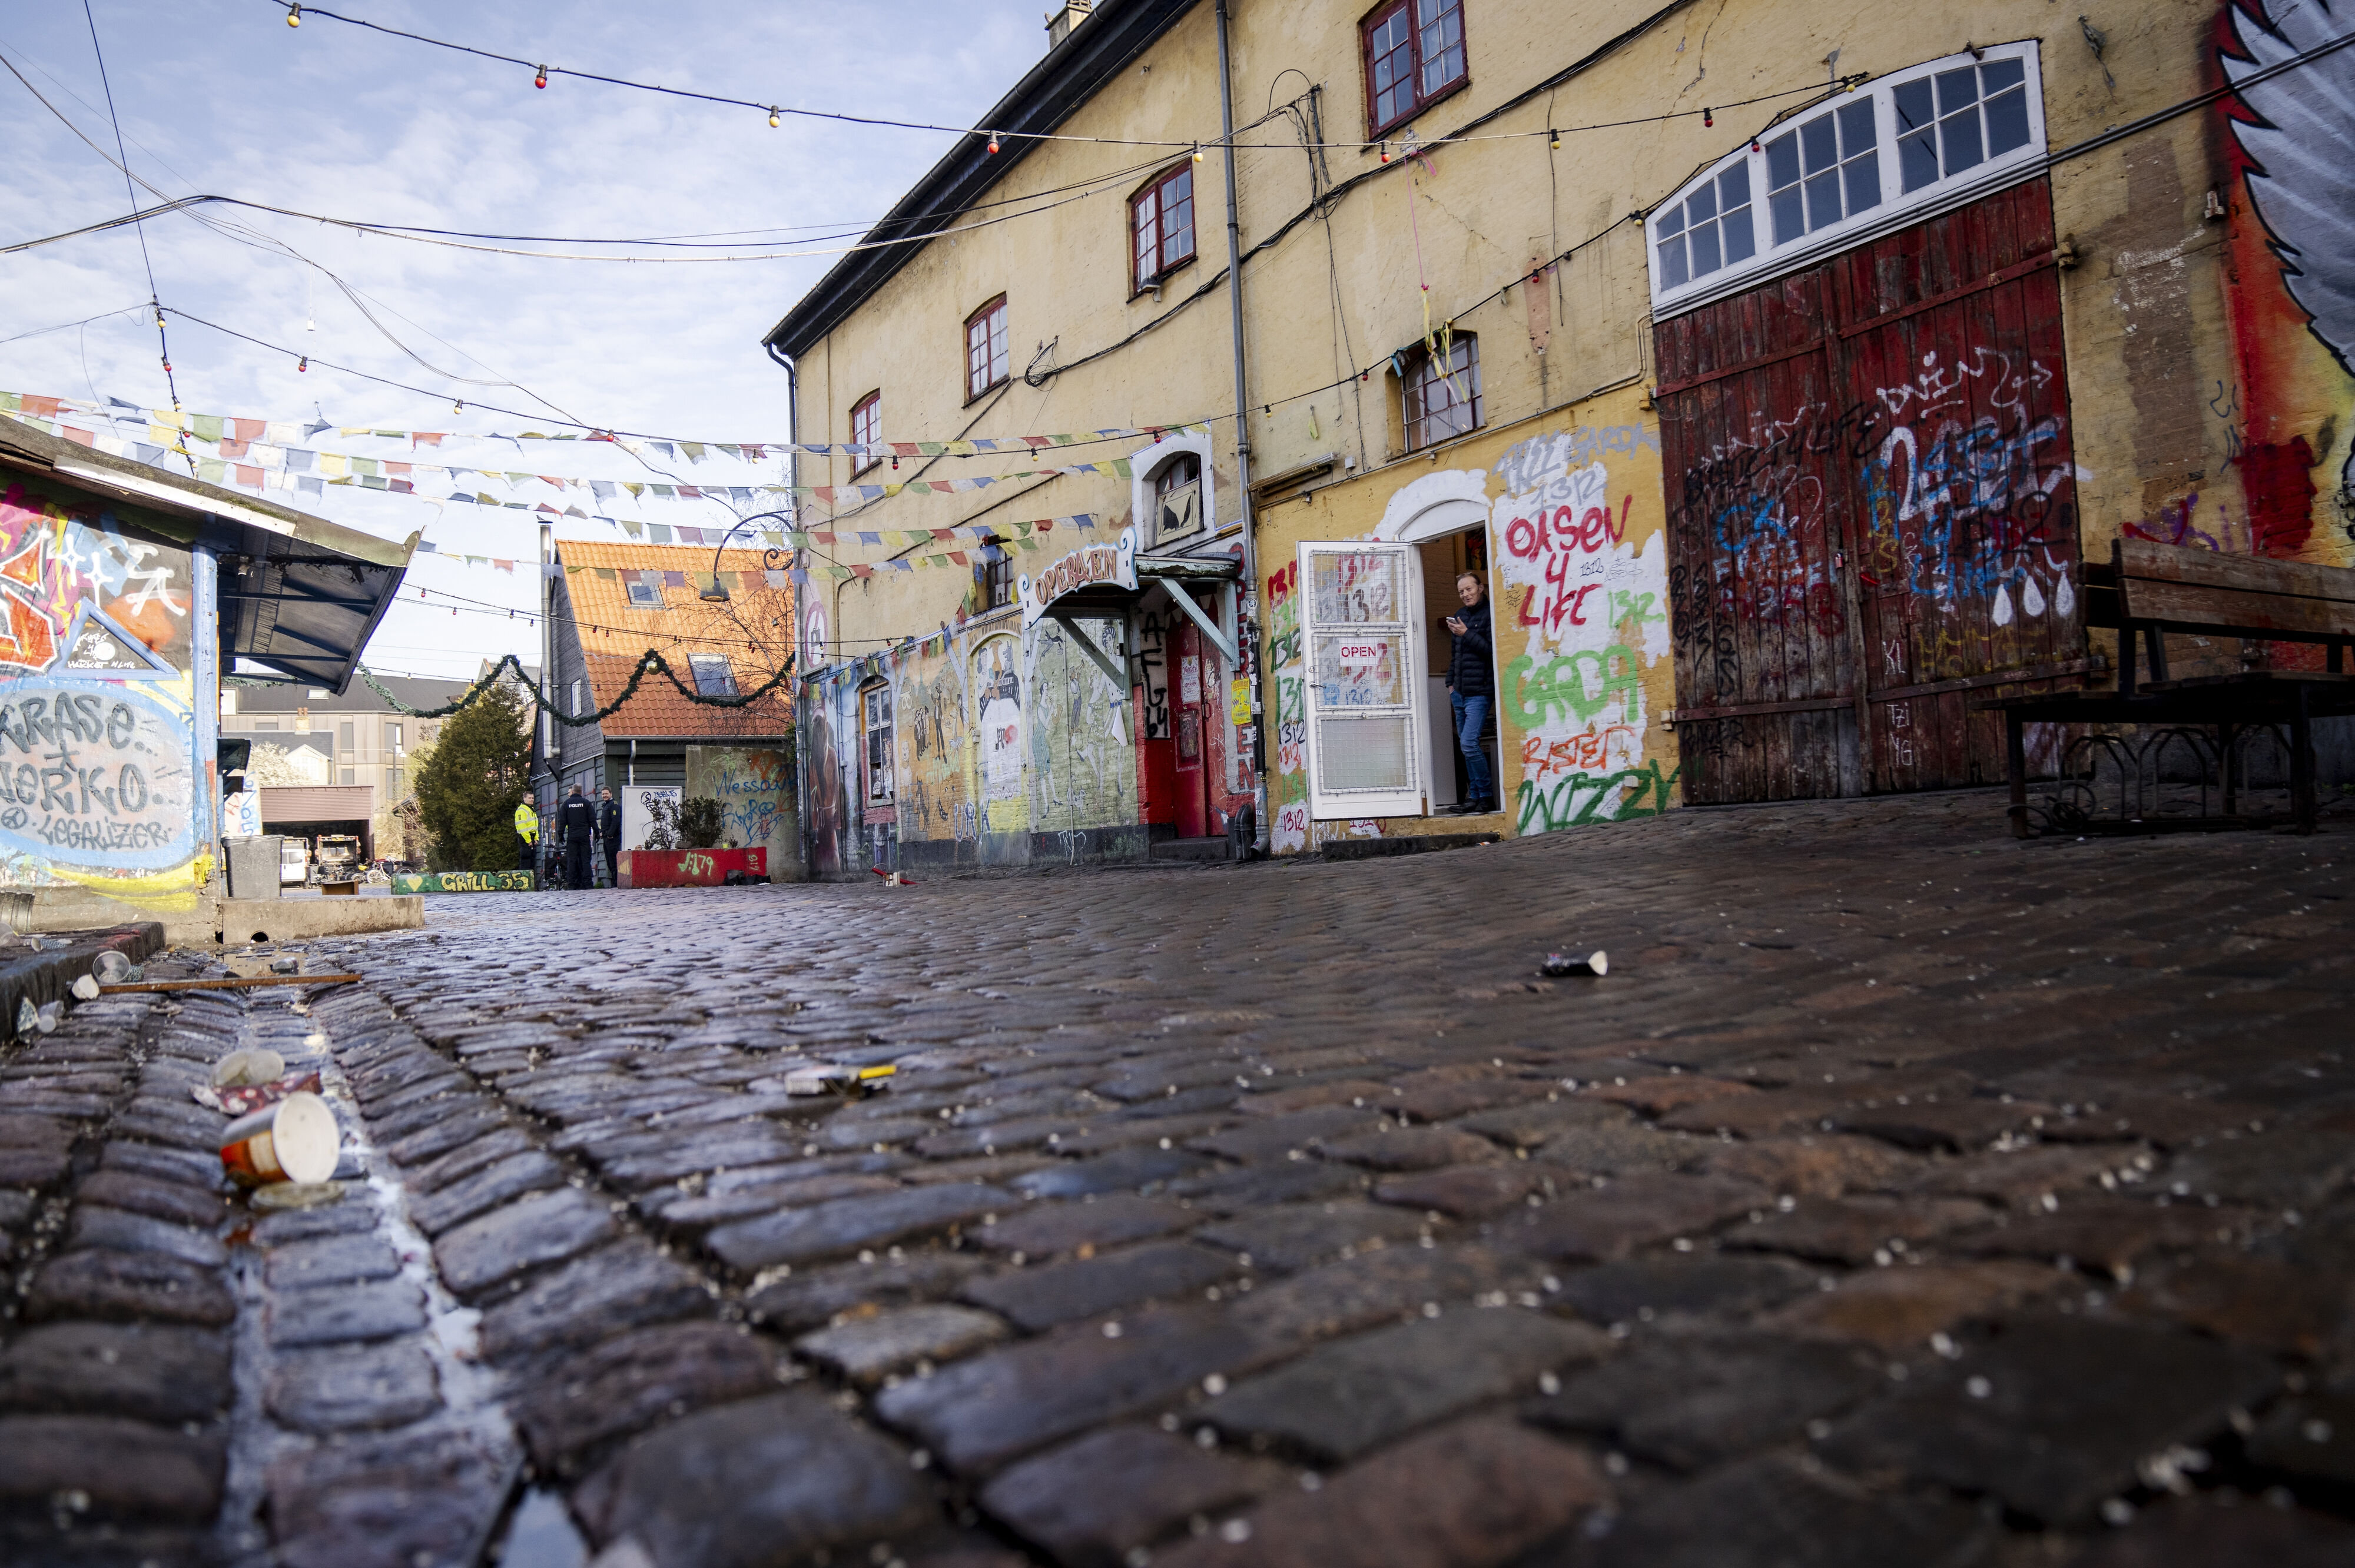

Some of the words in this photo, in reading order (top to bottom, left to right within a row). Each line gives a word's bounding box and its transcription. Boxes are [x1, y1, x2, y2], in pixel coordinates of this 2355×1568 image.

[1580, 558, 1604, 577] 1312
[1608, 589, 1666, 630] 1312
[1341, 646, 1376, 657] OPEN
[1279, 719, 1305, 744] 1312
[1283, 808, 1305, 831] 1312
[497, 872, 529, 891] 35
